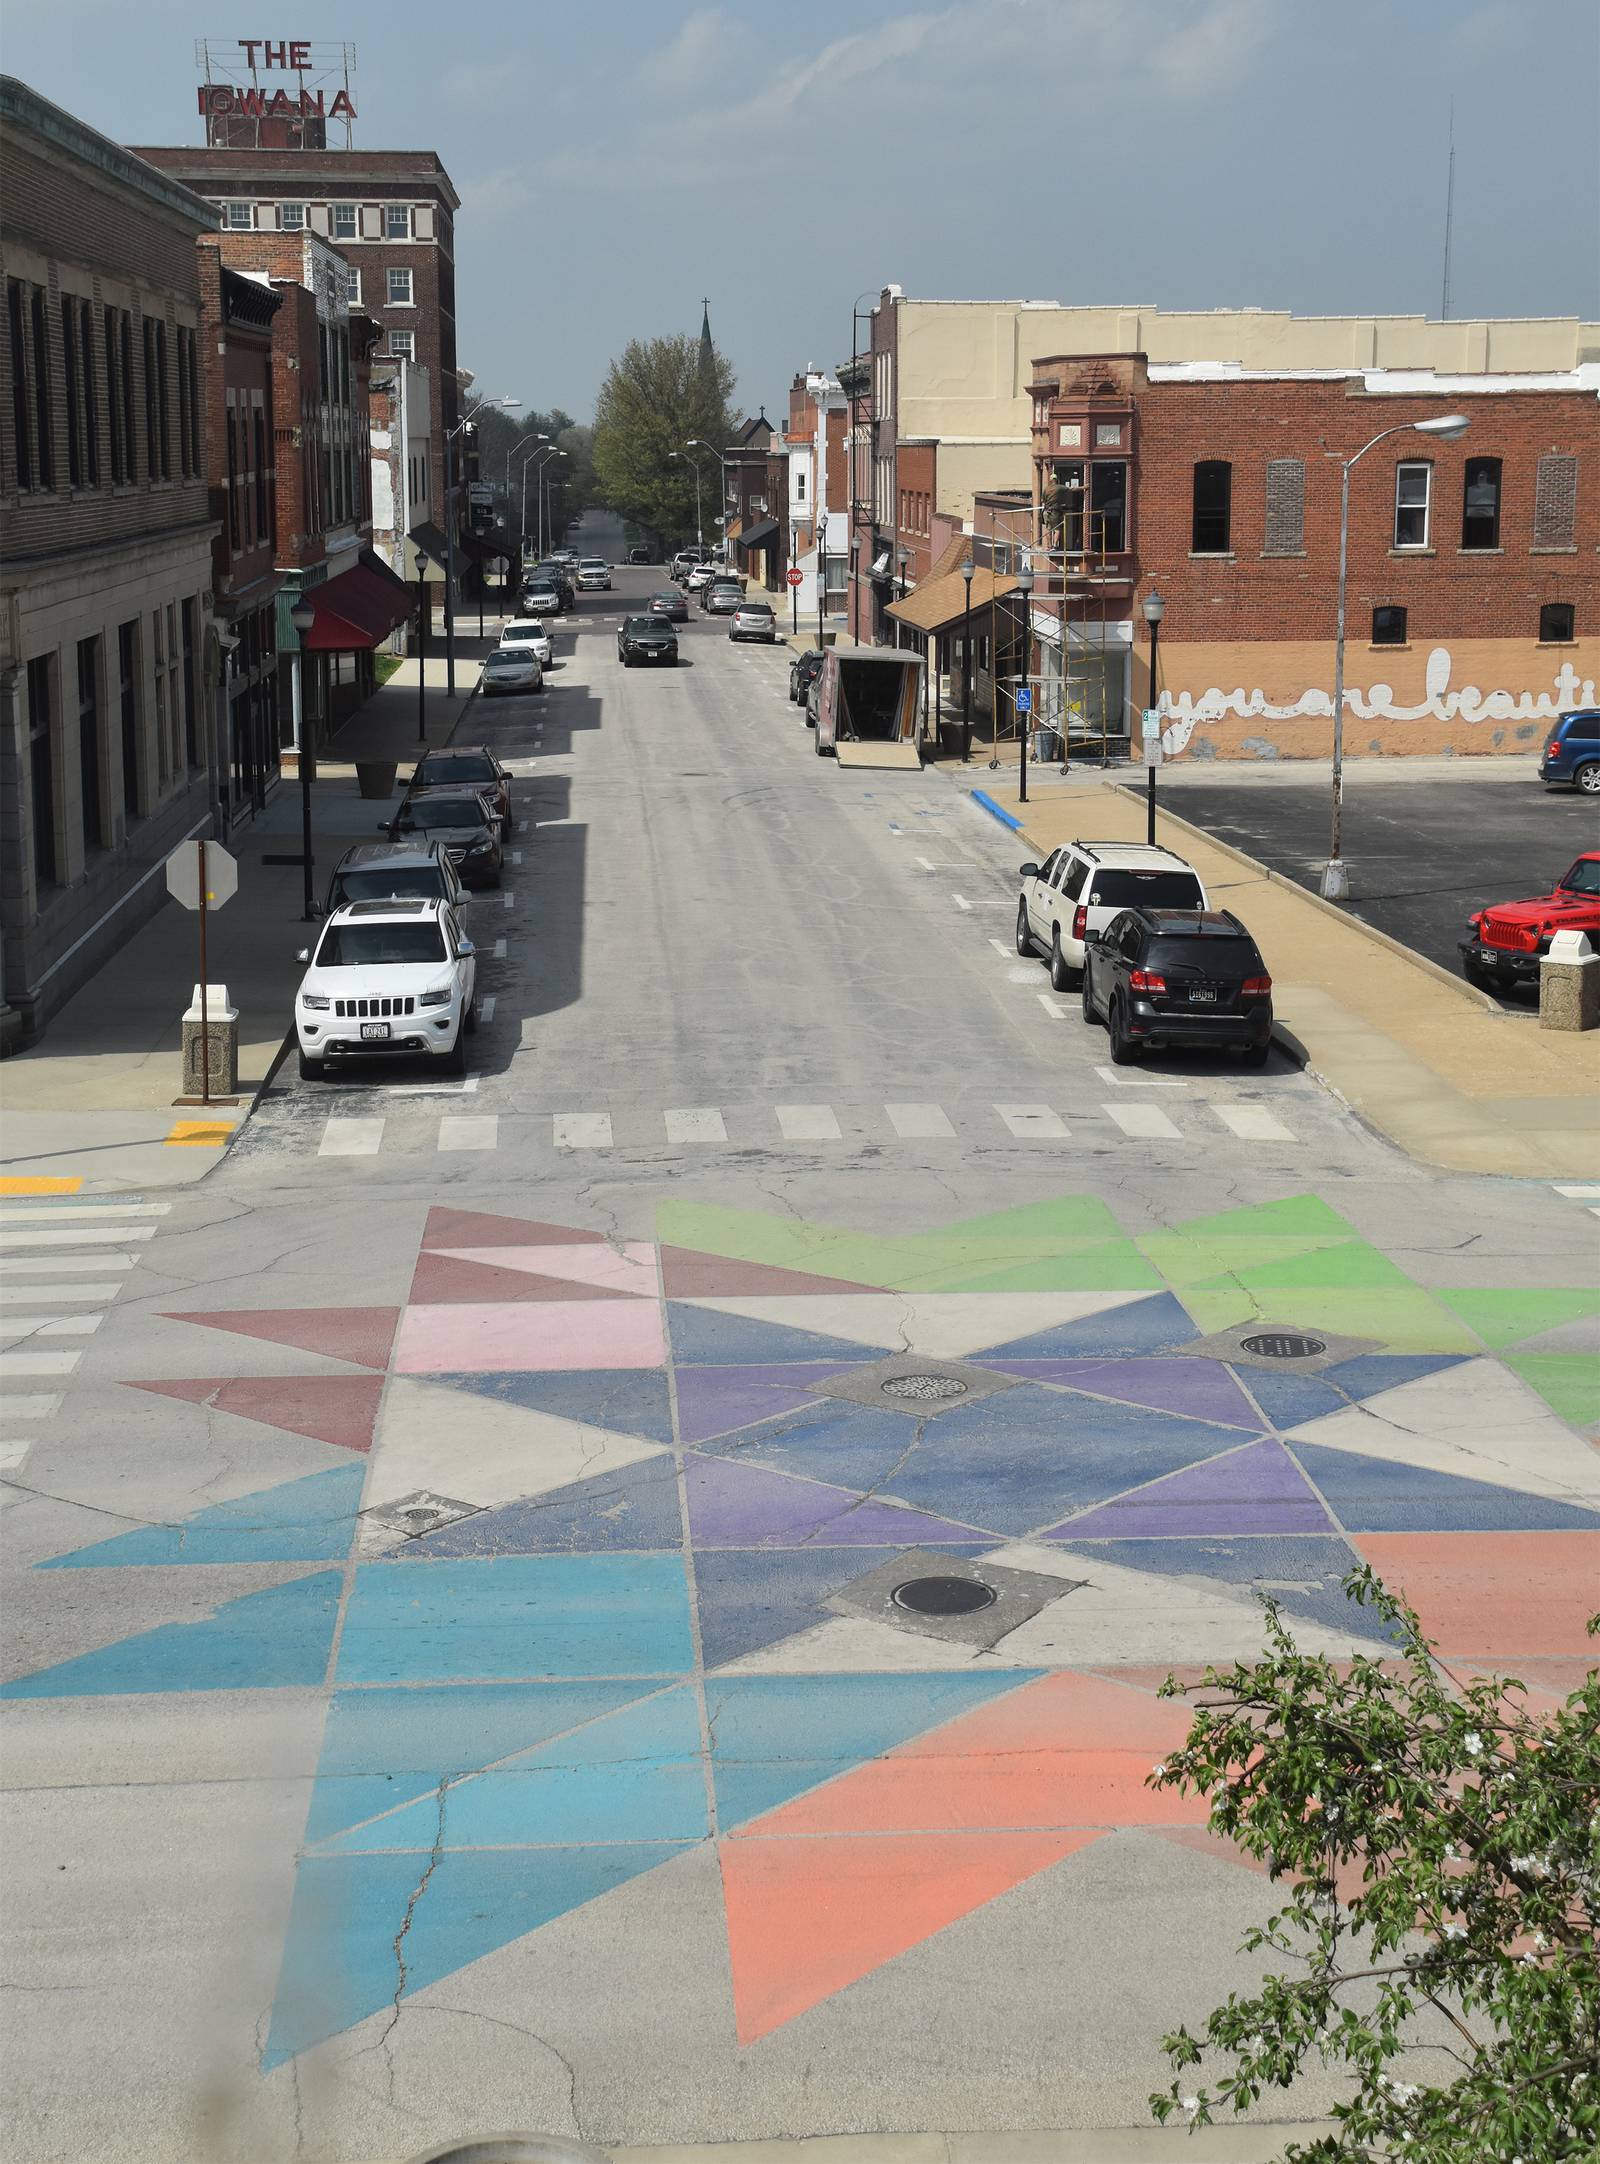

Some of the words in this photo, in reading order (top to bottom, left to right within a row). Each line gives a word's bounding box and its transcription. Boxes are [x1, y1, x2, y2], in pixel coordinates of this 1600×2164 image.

[238, 40, 313, 70] THE
[197, 87, 358, 119] IOWANA
[788, 573, 803, 581] STOP
[1156, 688, 1275, 755] you
[1292, 683, 1398, 721] are
